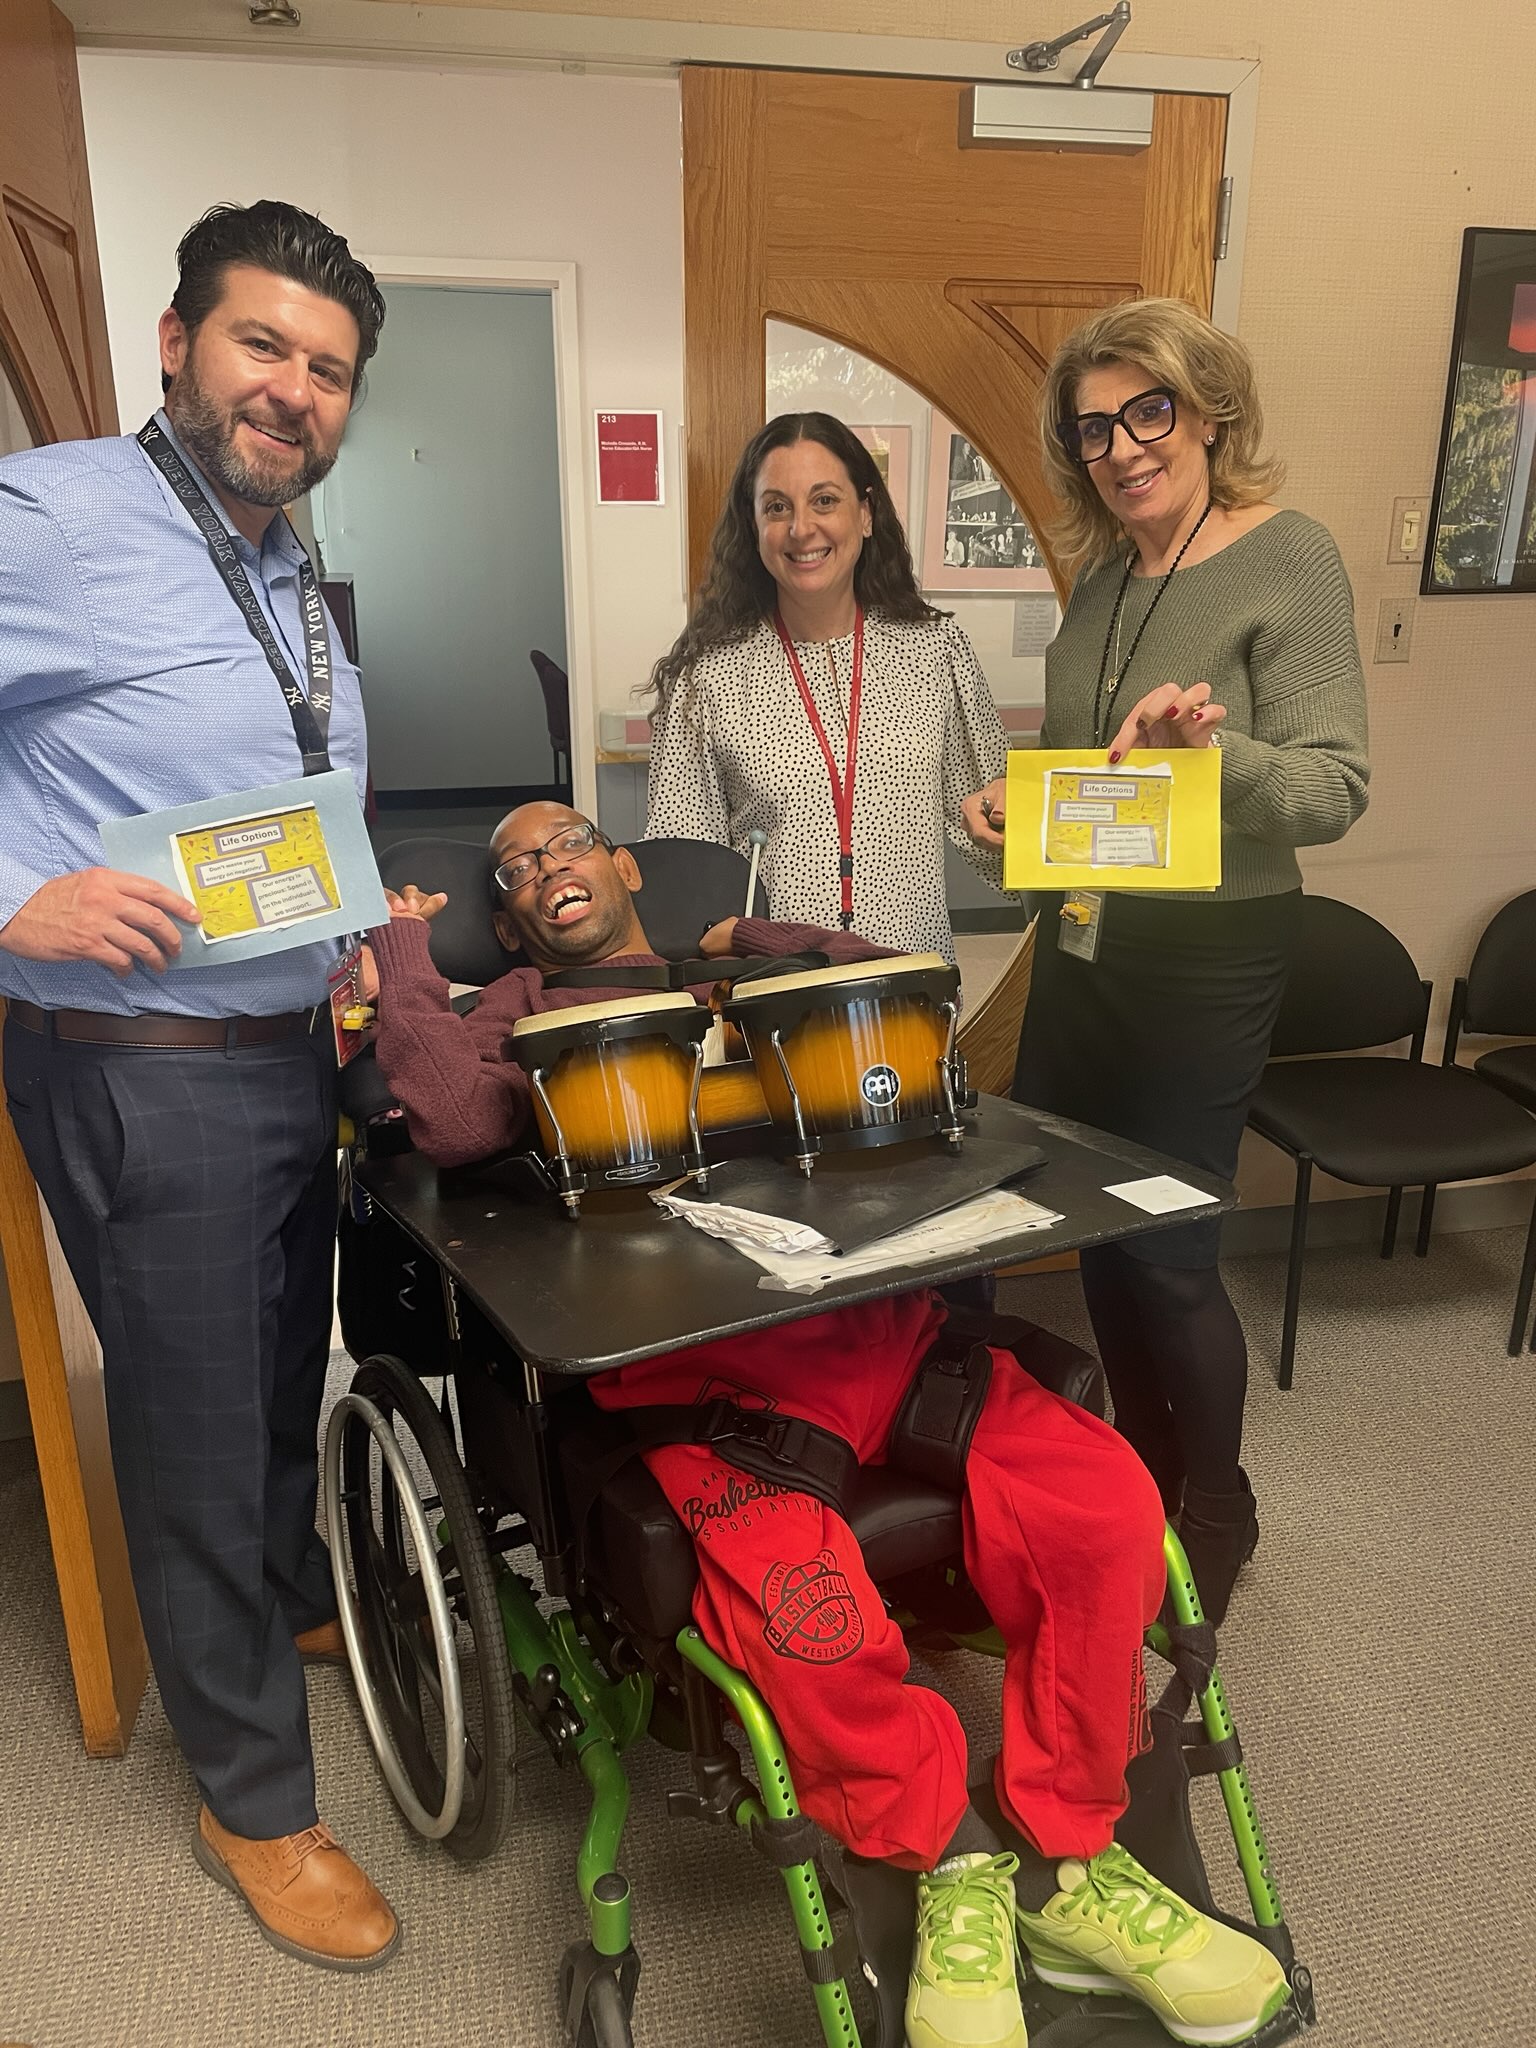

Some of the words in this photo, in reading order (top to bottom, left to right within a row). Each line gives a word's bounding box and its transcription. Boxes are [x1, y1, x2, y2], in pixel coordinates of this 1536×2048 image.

[601, 415, 617, 423] 213
[156, 451, 200, 498] NEW
[192, 503, 236, 562] YORK
[228, 565, 286, 670] YANKEES
[305, 584, 323, 634] YORK
[310, 640, 329, 680] NEW
[1101, 785, 1133, 794] Options
[221, 837, 240, 847] Life
[241, 829, 279, 842] Options
[275, 876, 295, 884] energy
[287, 881, 307, 890] Spend
[282, 889, 317, 903] individuals
[285, 902, 312, 913] support.
[768, 1576, 847, 1643] BASKETBALL
[801, 1642, 849, 1658] WESTERN
[1130, 1649, 1138, 1702] NATIONAL
